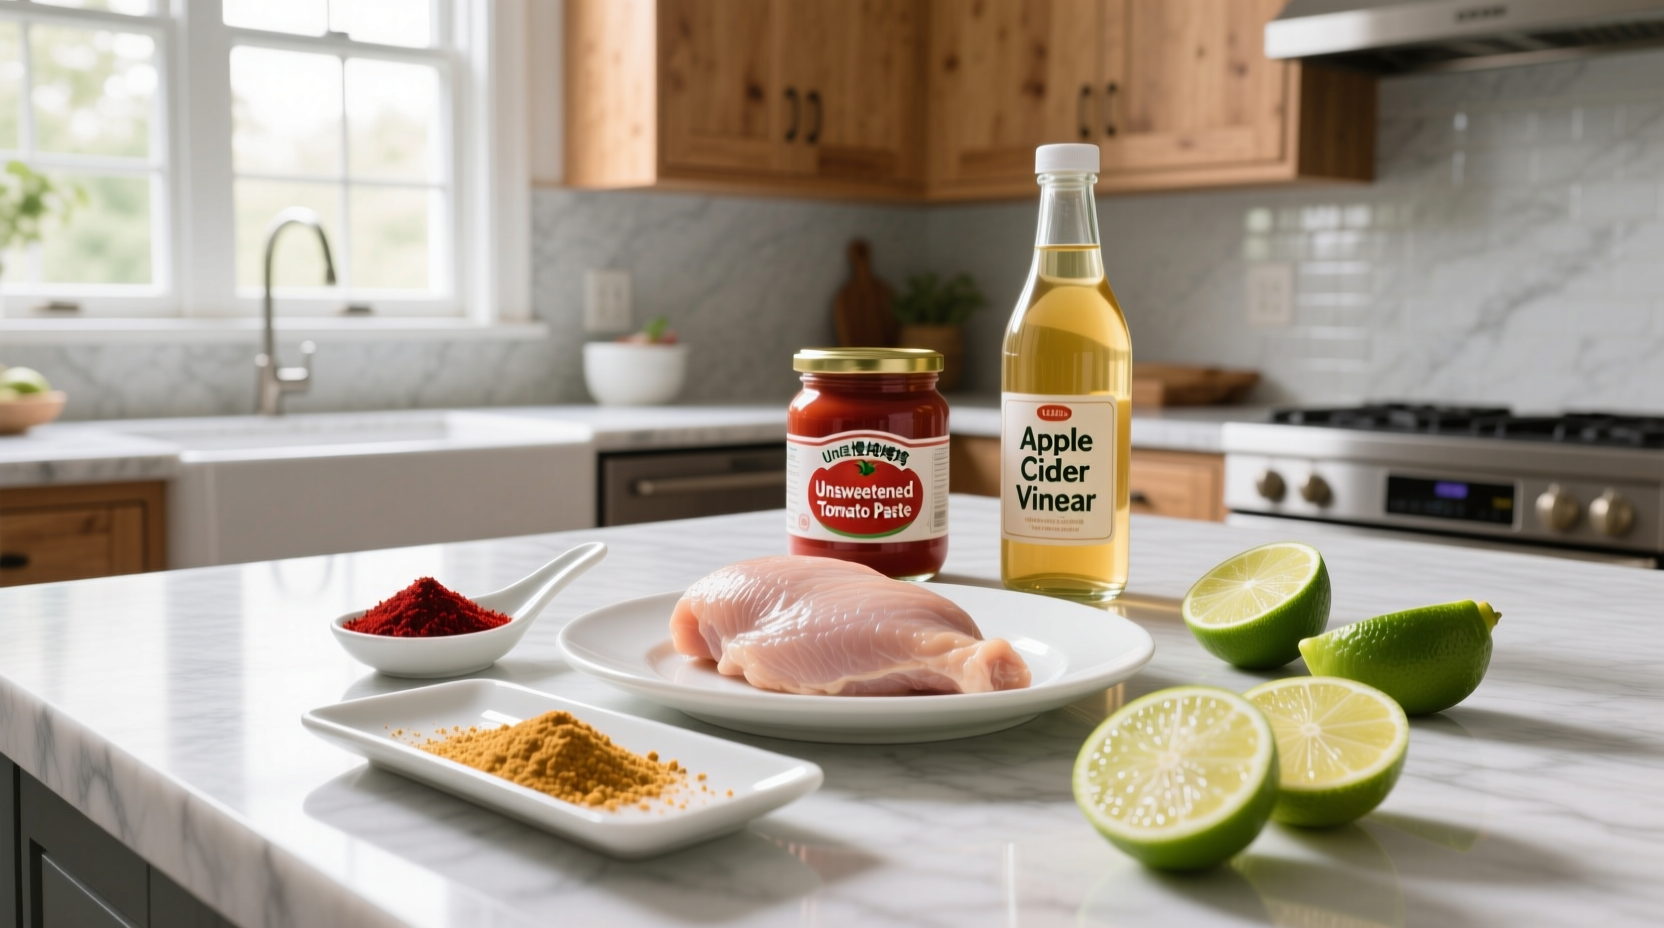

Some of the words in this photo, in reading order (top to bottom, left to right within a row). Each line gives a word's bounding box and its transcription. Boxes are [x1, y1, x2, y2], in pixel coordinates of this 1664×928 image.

[1019, 425, 1093, 456] Apple
[1020, 455, 1090, 482] Cider
[815, 479, 914, 500] Unsweetened
[1016, 484, 1097, 512] Vinear
[816, 500, 870, 519] Tomato
